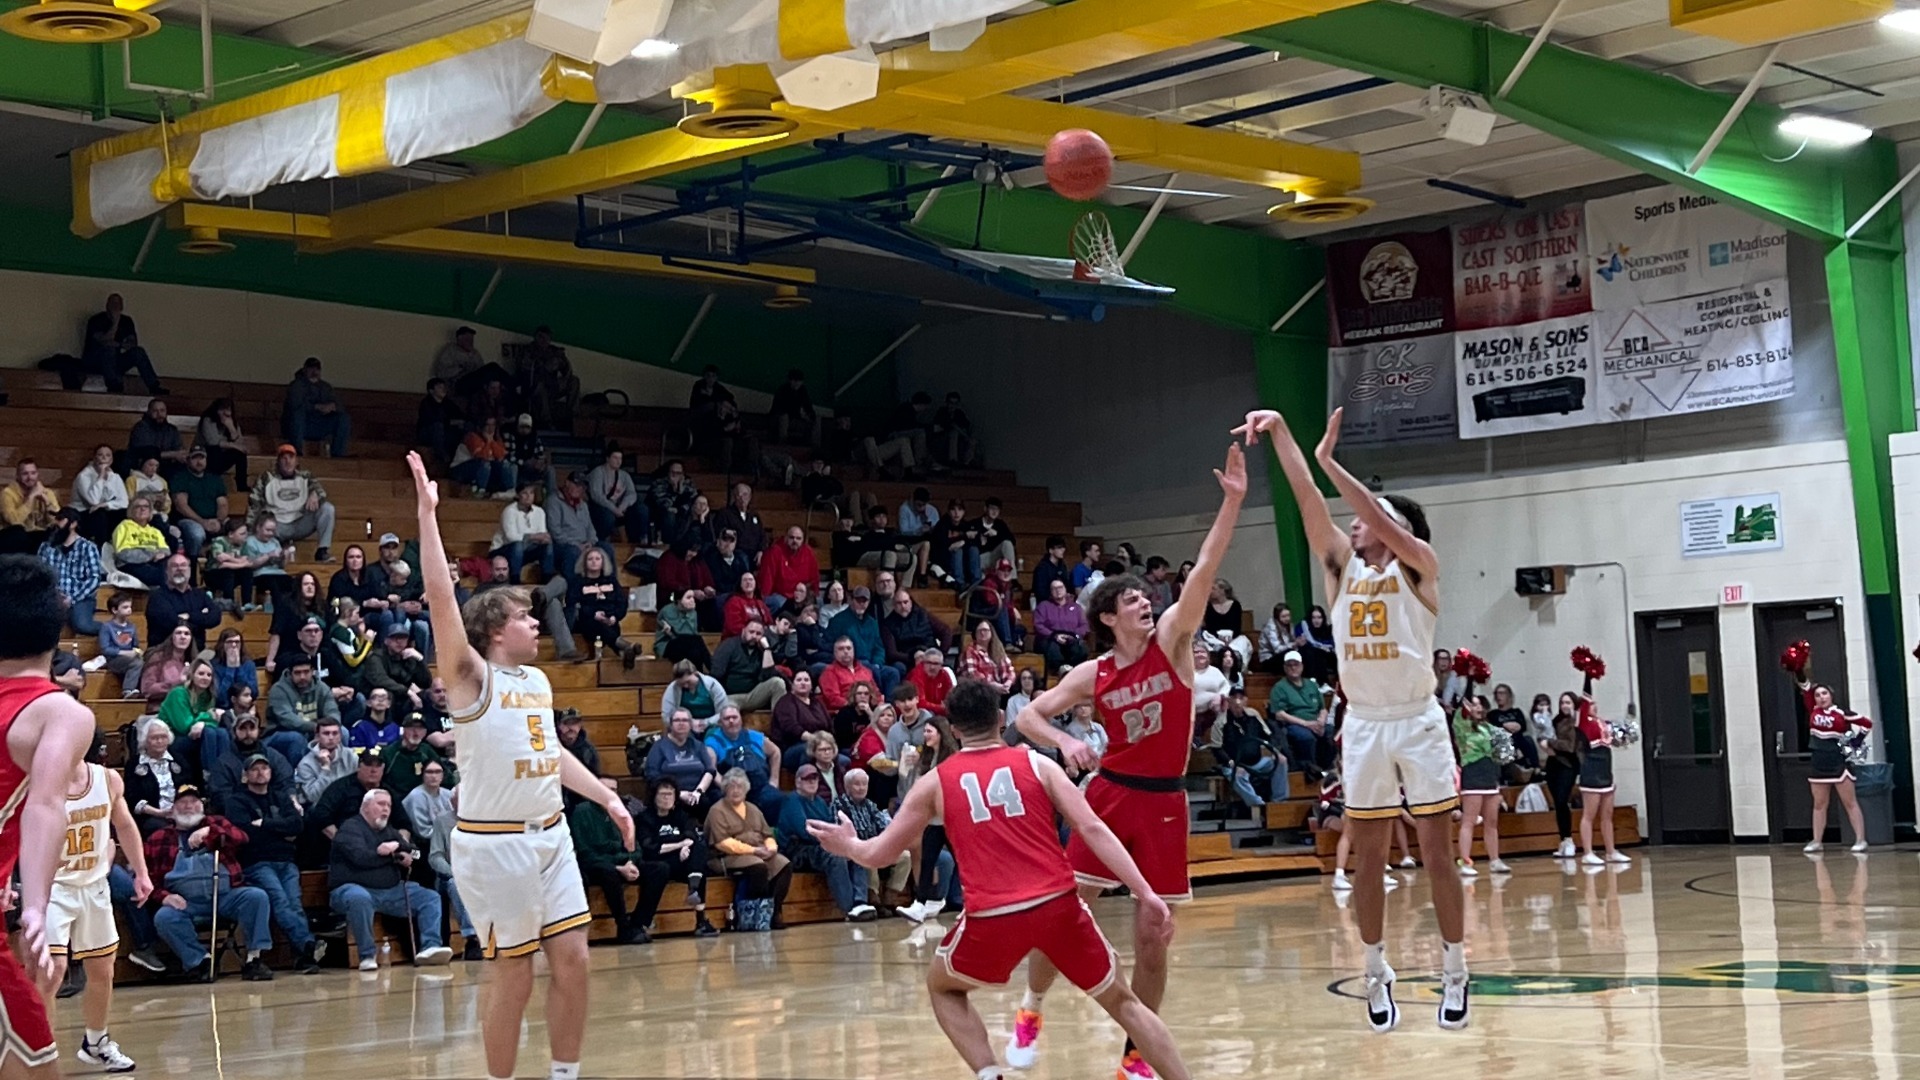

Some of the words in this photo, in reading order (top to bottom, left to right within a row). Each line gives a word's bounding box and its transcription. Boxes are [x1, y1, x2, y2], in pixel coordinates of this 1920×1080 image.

[1634, 200, 1676, 222] Sports
[1462, 247, 1497, 271] CAST
[1503, 234, 1579, 265] SOUTHERN
[1624, 248, 1690, 270] NATIONWIDE
[1731, 249, 1769, 263] HEALTH
[1464, 267, 1544, 297] BAR-B-QUE
[1383, 319, 1444, 335] RESTAURANT
[1462, 337, 1523, 360] MASON
[1529, 336, 1539, 352] &
[1544, 325, 1589, 348] SONS
[1623, 336, 1649, 355] BCA
[1376, 342, 1417, 370] CK
[1474, 351, 1550, 369] DUMPSTERS
[1556, 345, 1577, 359] LLC
[1604, 350, 1695, 371] MECHANICAL
[1465, 358, 1588, 386] 614-506-6524
[1724, 585, 1743, 602] EXIT
[1349, 600, 1388, 637] 23
[1344, 641, 1400, 661] PLAINS
[1101, 671, 1173, 710] TROJANS
[527, 714, 546, 751] 5
[1814, 714, 1835, 728] SHS
[959, 766, 1026, 824] 14
[66, 825, 94, 856] 12
